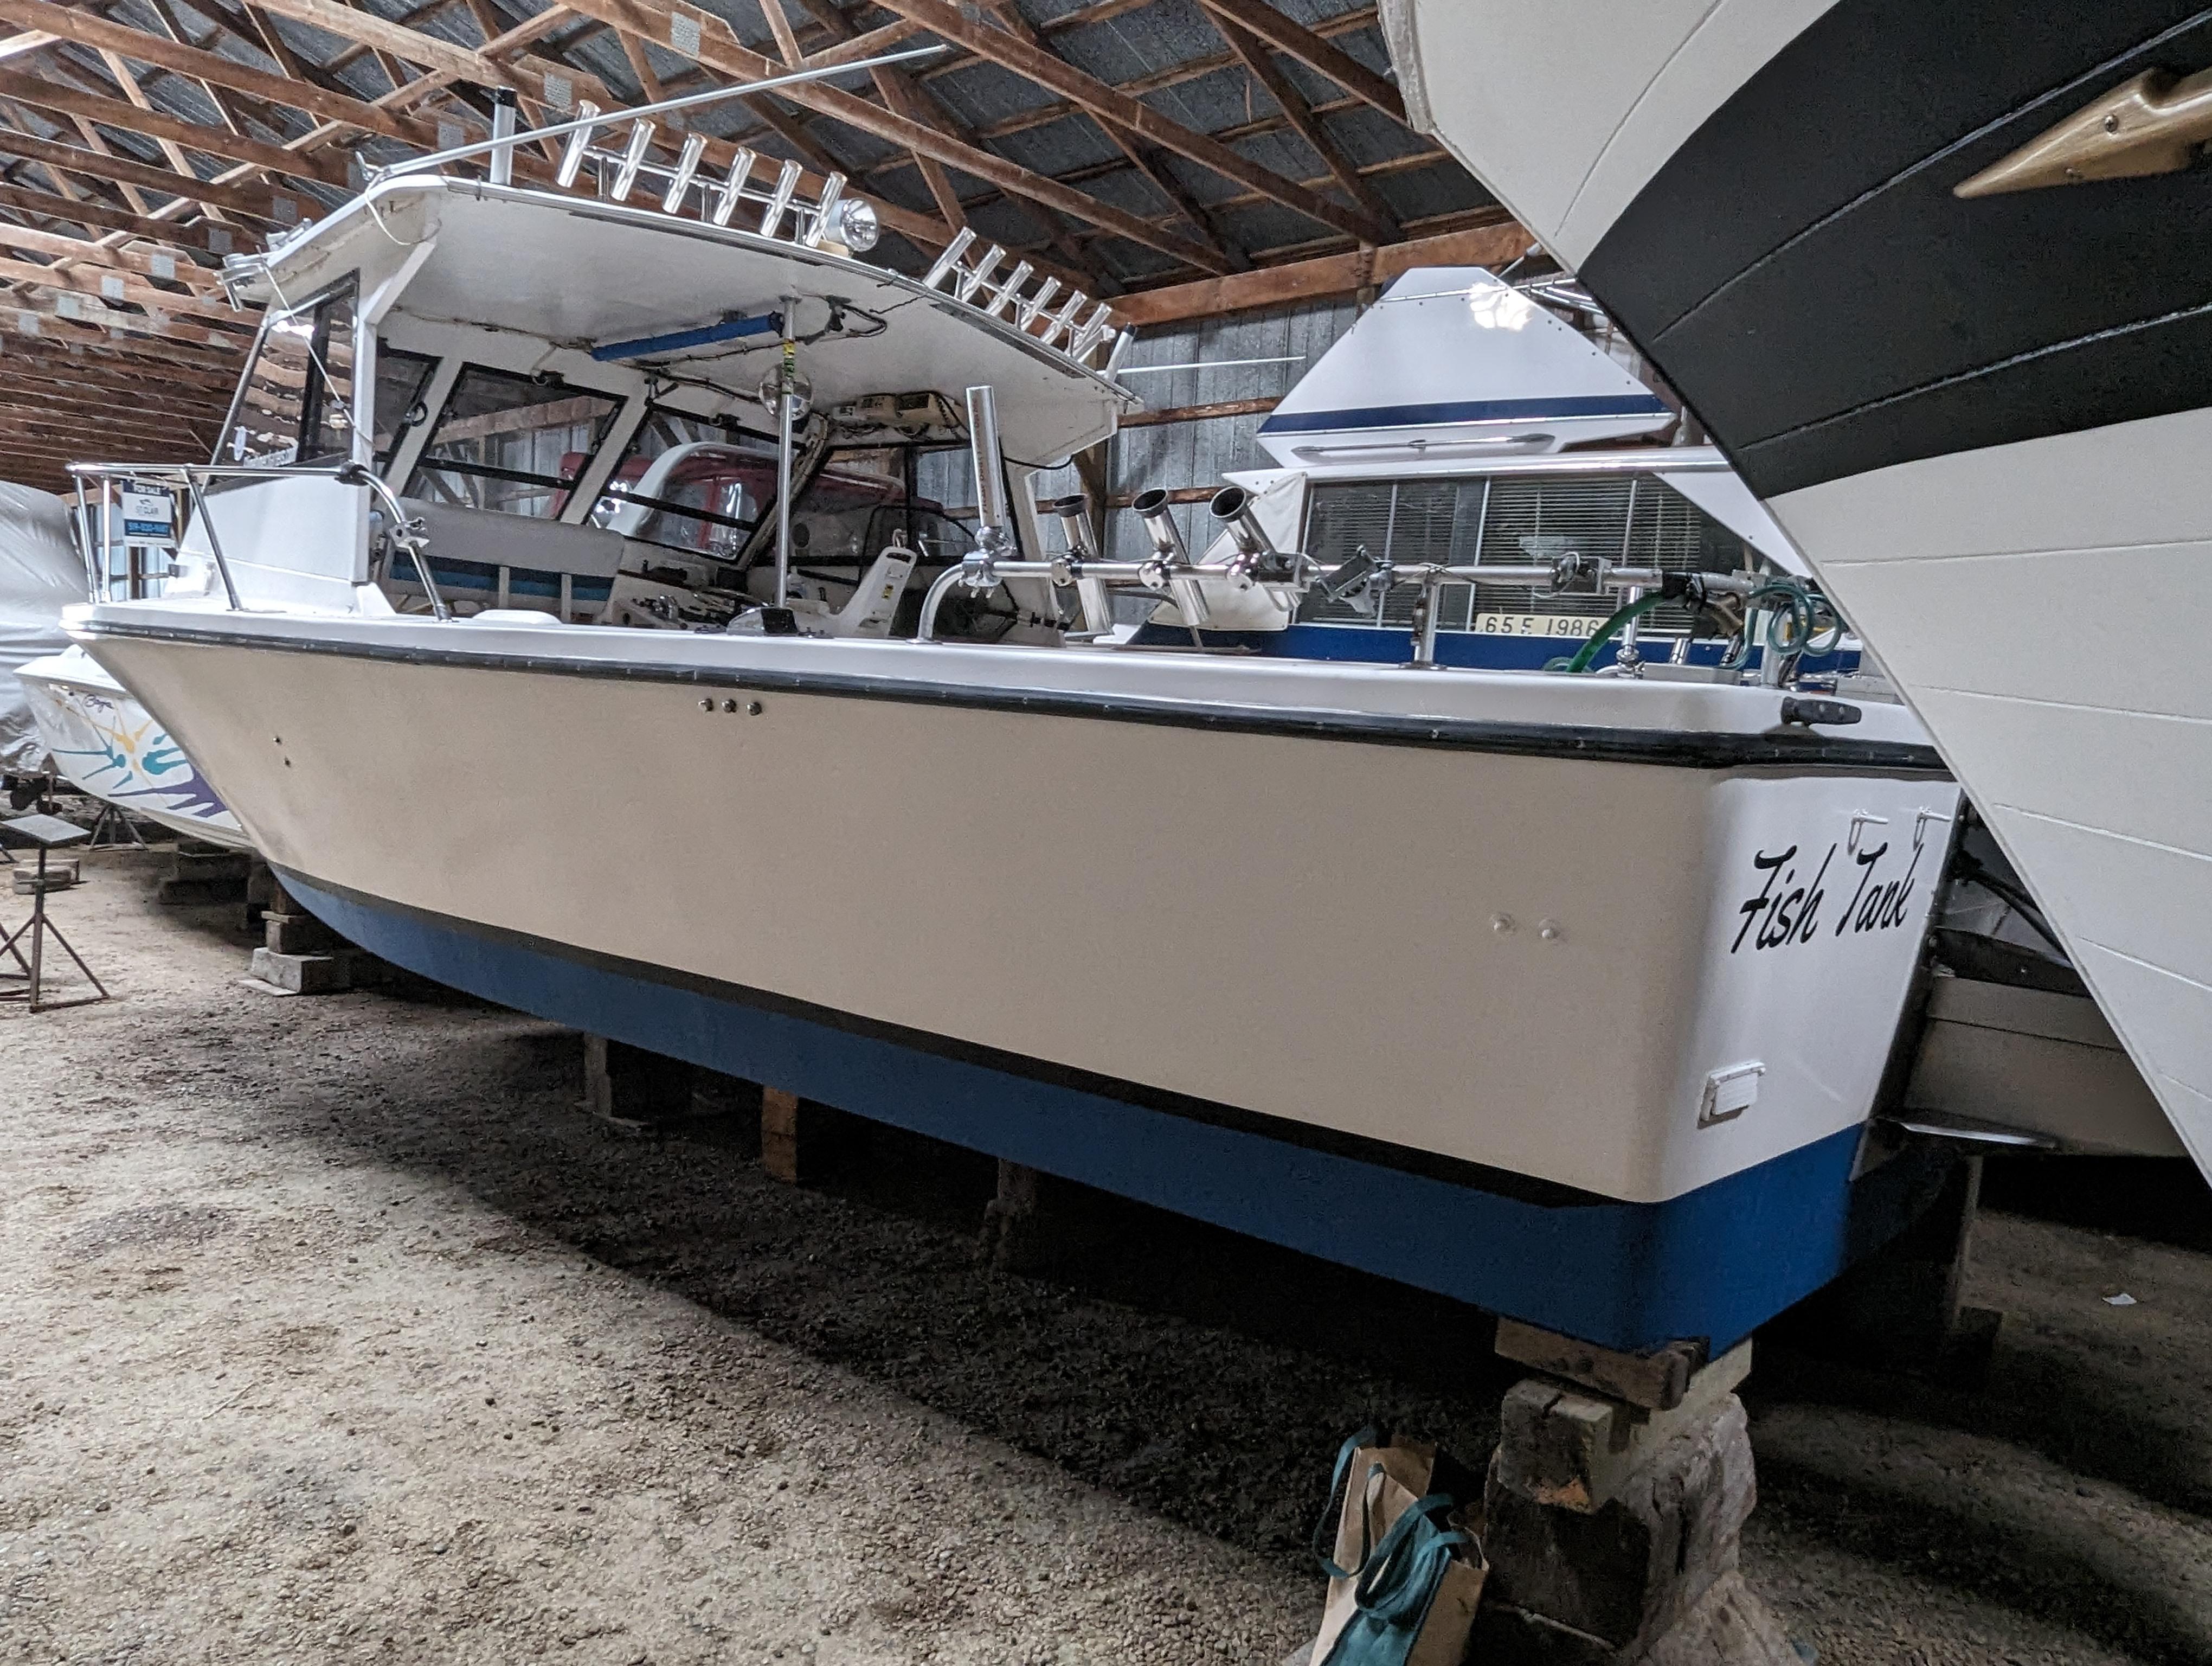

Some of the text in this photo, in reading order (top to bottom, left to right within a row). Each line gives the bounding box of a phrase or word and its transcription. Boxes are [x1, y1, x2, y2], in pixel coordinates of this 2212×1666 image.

[133, 484, 161, 495] FOR SALE
[1731, 842, 1925, 953] Fish Tank
